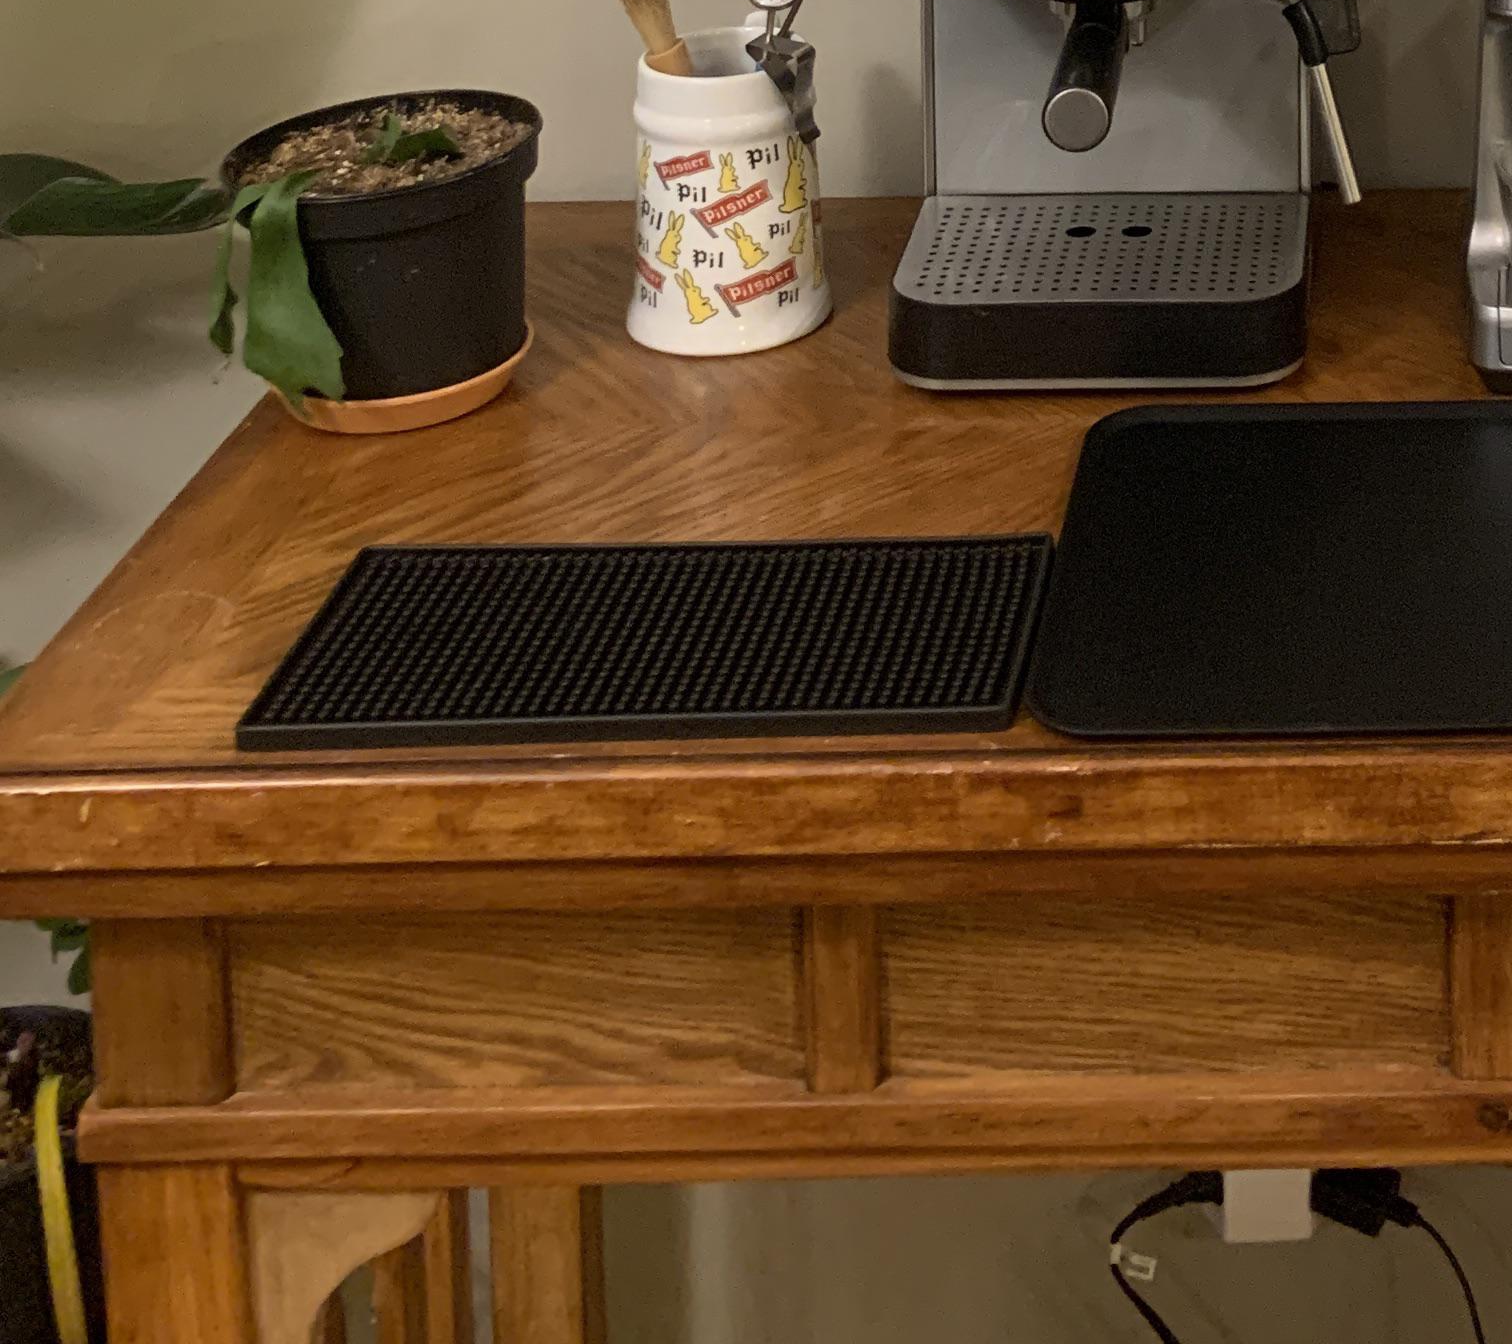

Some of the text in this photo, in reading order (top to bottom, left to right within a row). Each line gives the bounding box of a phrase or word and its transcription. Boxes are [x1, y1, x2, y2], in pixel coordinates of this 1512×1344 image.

[661, 156, 706, 176] Pilsner
[745, 144, 780, 170] Pil
[676, 182, 707, 203] Pil
[641, 196, 663, 231] Pil
[703, 188, 764, 224] Pilsner
[768, 220, 791, 239] Pil
[692, 249, 724, 269] Pil
[729, 268, 791, 300] Pilsner
[640, 284, 657, 308] Pil
[777, 288, 800, 307] Pil
